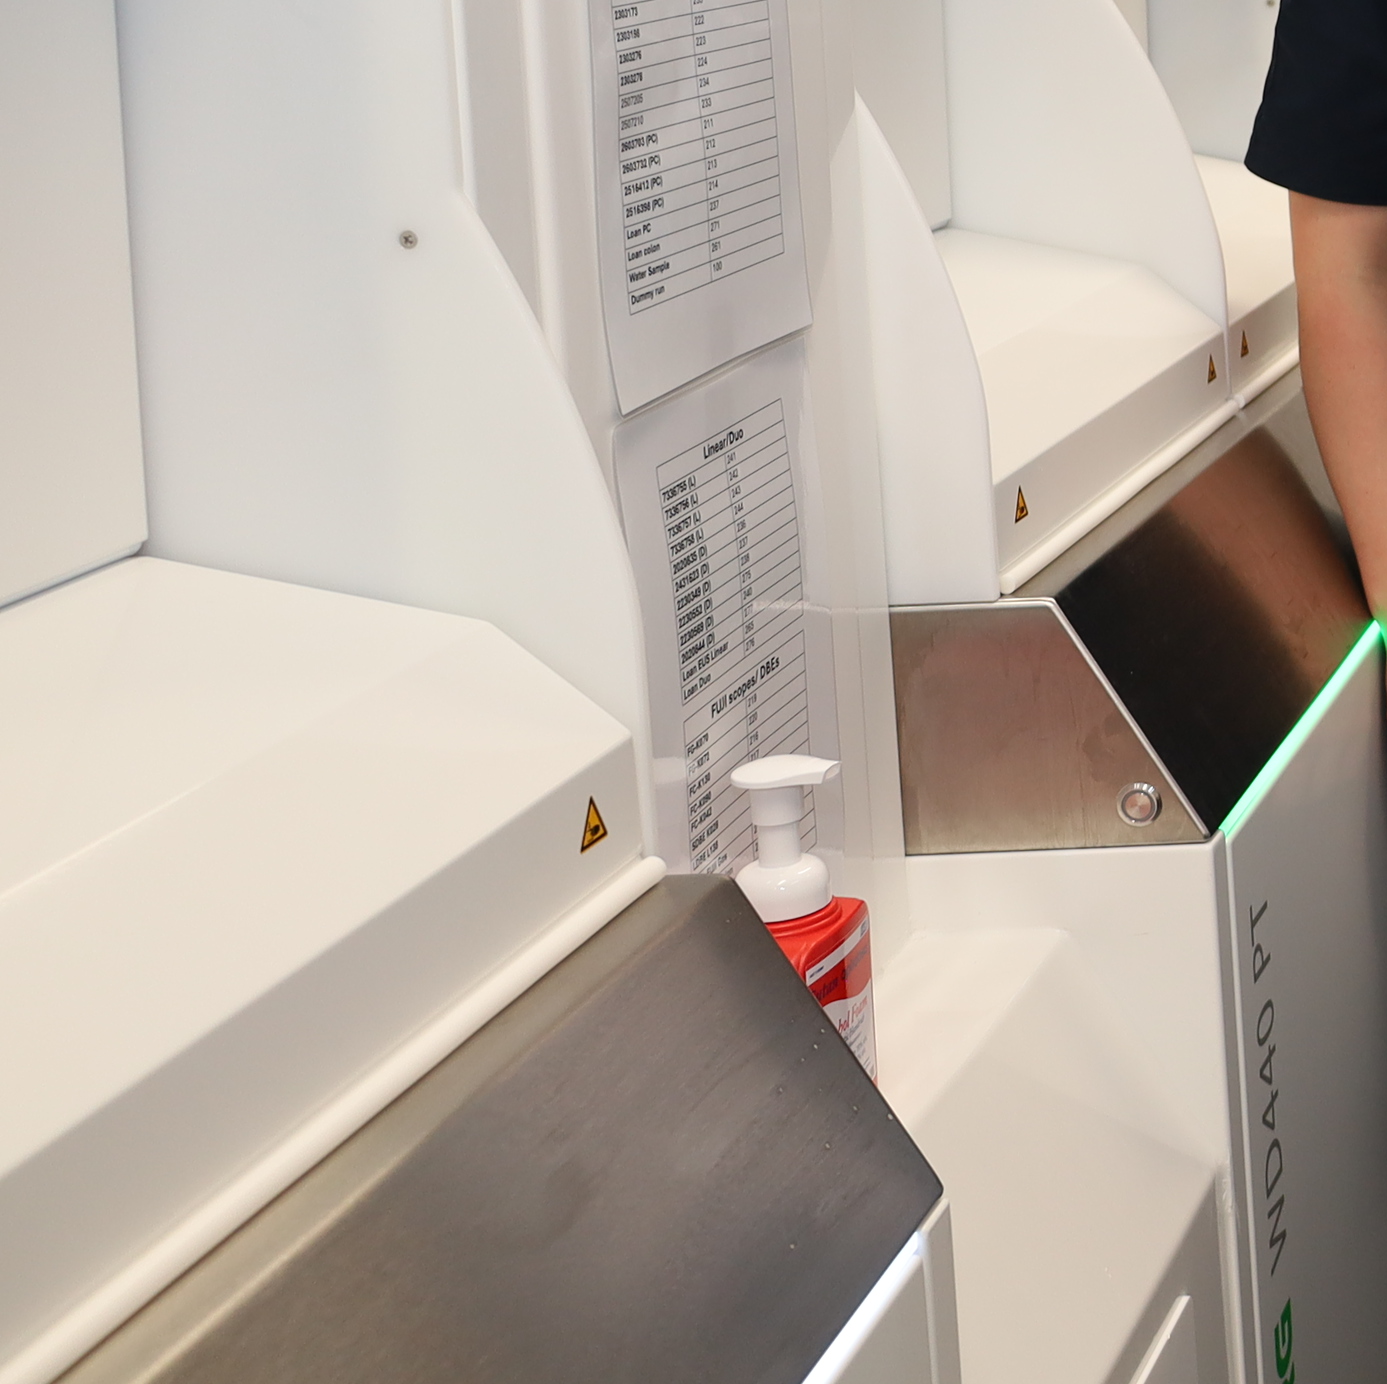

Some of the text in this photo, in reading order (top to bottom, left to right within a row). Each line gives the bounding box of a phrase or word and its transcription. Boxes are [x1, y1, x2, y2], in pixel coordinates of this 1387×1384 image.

[697, 56, 708, 67] 224
[699, 77, 710, 88] 234
[701, 97, 712, 109] 233
[703, 118, 714, 129] 211
[705, 138, 716, 150] 212
[708, 179, 719, 191] 214
[626, 226, 641, 240] Loan
[642, 223, 651, 234] PC
[628, 247, 643, 262] Loan
[643, 242, 660, 255] colon
[629, 267, 647, 283] Water
[648, 260, 670, 277] Sample
[631, 285, 665, 306] Dummy run
[703, 428, 743, 459] Linear/Duo
[682, 641, 729, 682] Loan EUS Linear
[684, 673, 711, 700] Loan Duo
[711, 694, 727, 718] FUJI
[760, 656, 780, 679] DBEs
[1249, 899, 1288, 1277] WD440 PT
